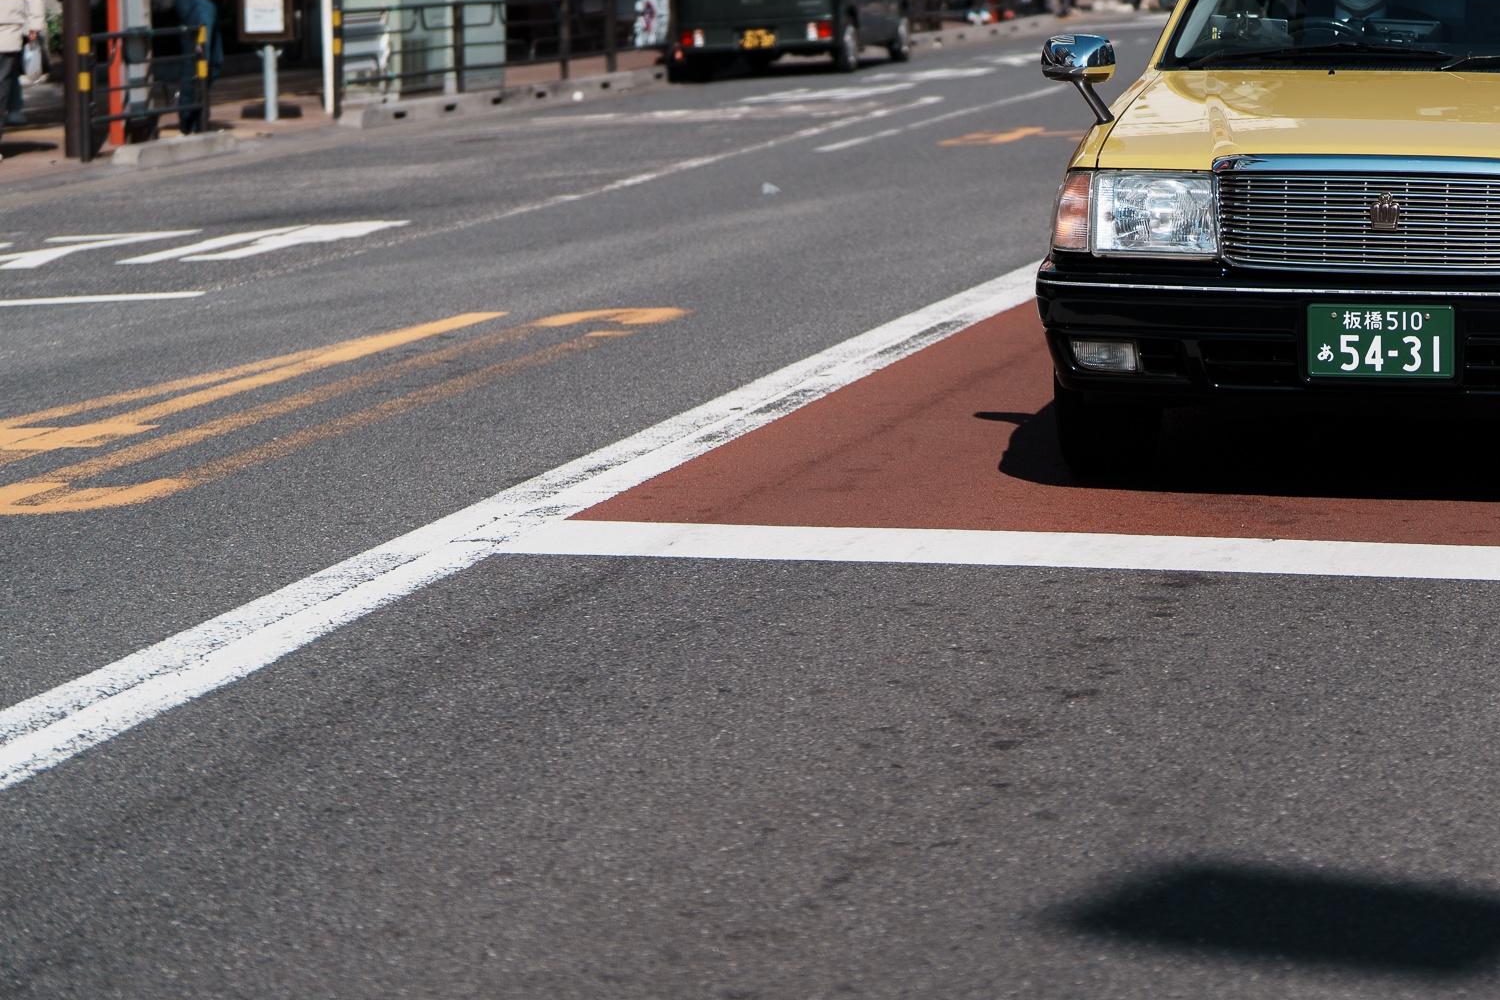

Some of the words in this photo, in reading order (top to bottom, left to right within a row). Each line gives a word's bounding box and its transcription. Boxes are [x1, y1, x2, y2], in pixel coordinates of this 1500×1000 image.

[1342, 310, 1423, 331] 板橋510
[1317, 343, 1334, 362] あ
[1339, 334, 1440, 373] 54-31
